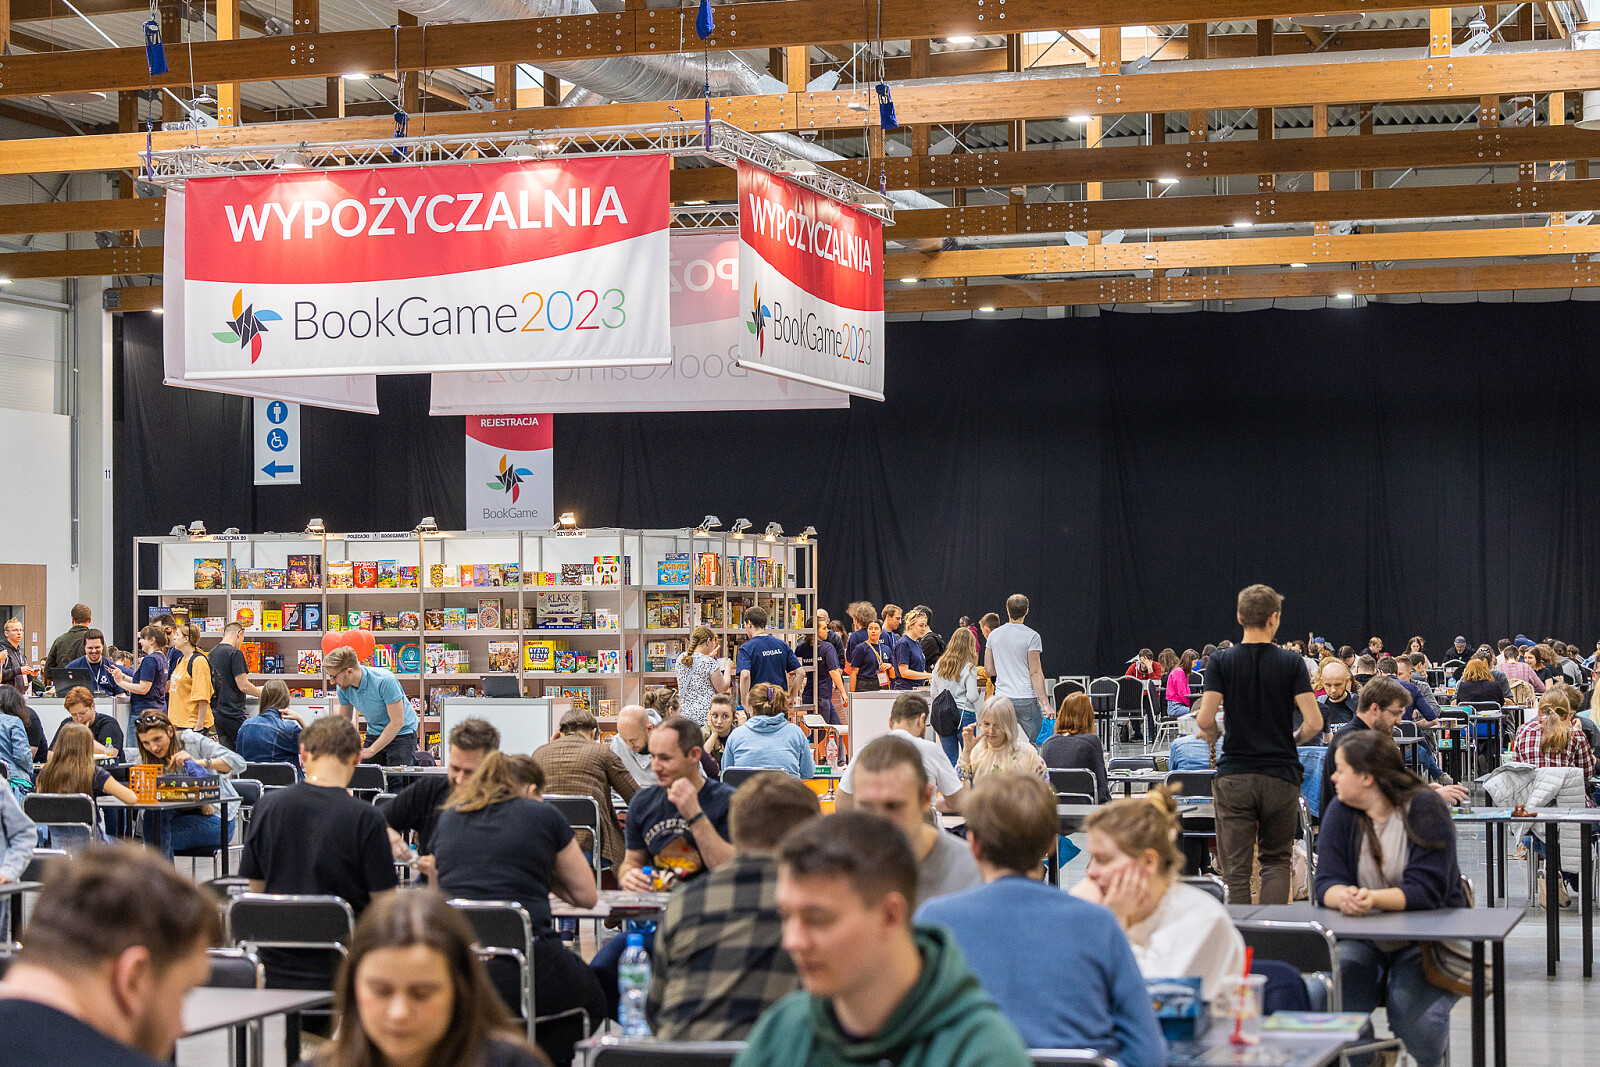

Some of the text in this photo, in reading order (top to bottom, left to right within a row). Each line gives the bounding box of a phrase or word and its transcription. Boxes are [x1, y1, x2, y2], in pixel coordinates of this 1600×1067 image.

[225, 186, 628, 242] WYPOŻYCZALNIA
[749, 193, 872, 275] WYPOŻYCZALNIA
[480, 417, 539, 427] REJESTRACJA
[104, 469, 111, 479] 11
[483, 507, 538, 519] BookGame
[662, 562, 689, 570] ACTIVITY
[547, 593, 571, 603] KLASK
[762, 649, 782, 657] ROGAL
